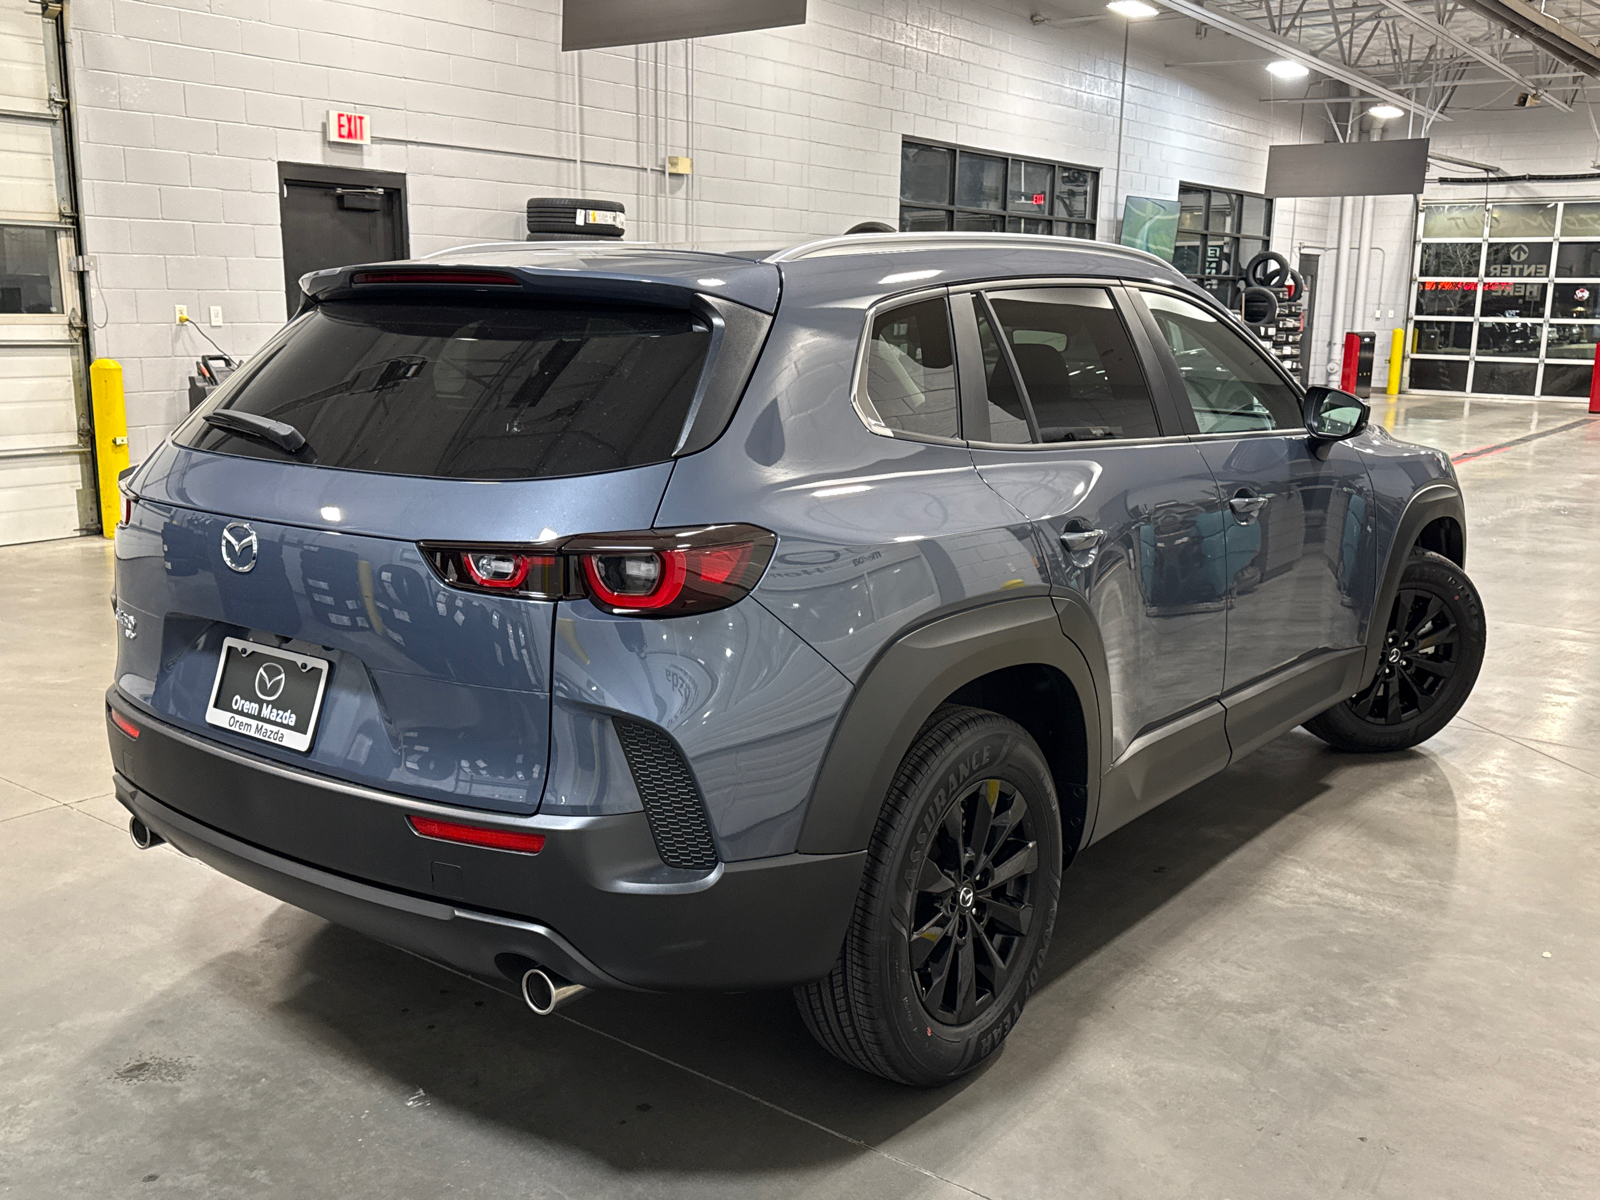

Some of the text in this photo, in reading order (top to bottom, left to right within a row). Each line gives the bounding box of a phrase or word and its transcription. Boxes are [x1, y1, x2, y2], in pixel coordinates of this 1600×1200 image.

[337, 113, 365, 141] EXIT
[231, 694, 297, 727] Orem Mazda
[227, 715, 285, 743] Orem Mazda
[903, 745, 992, 892] ASSURANCE
